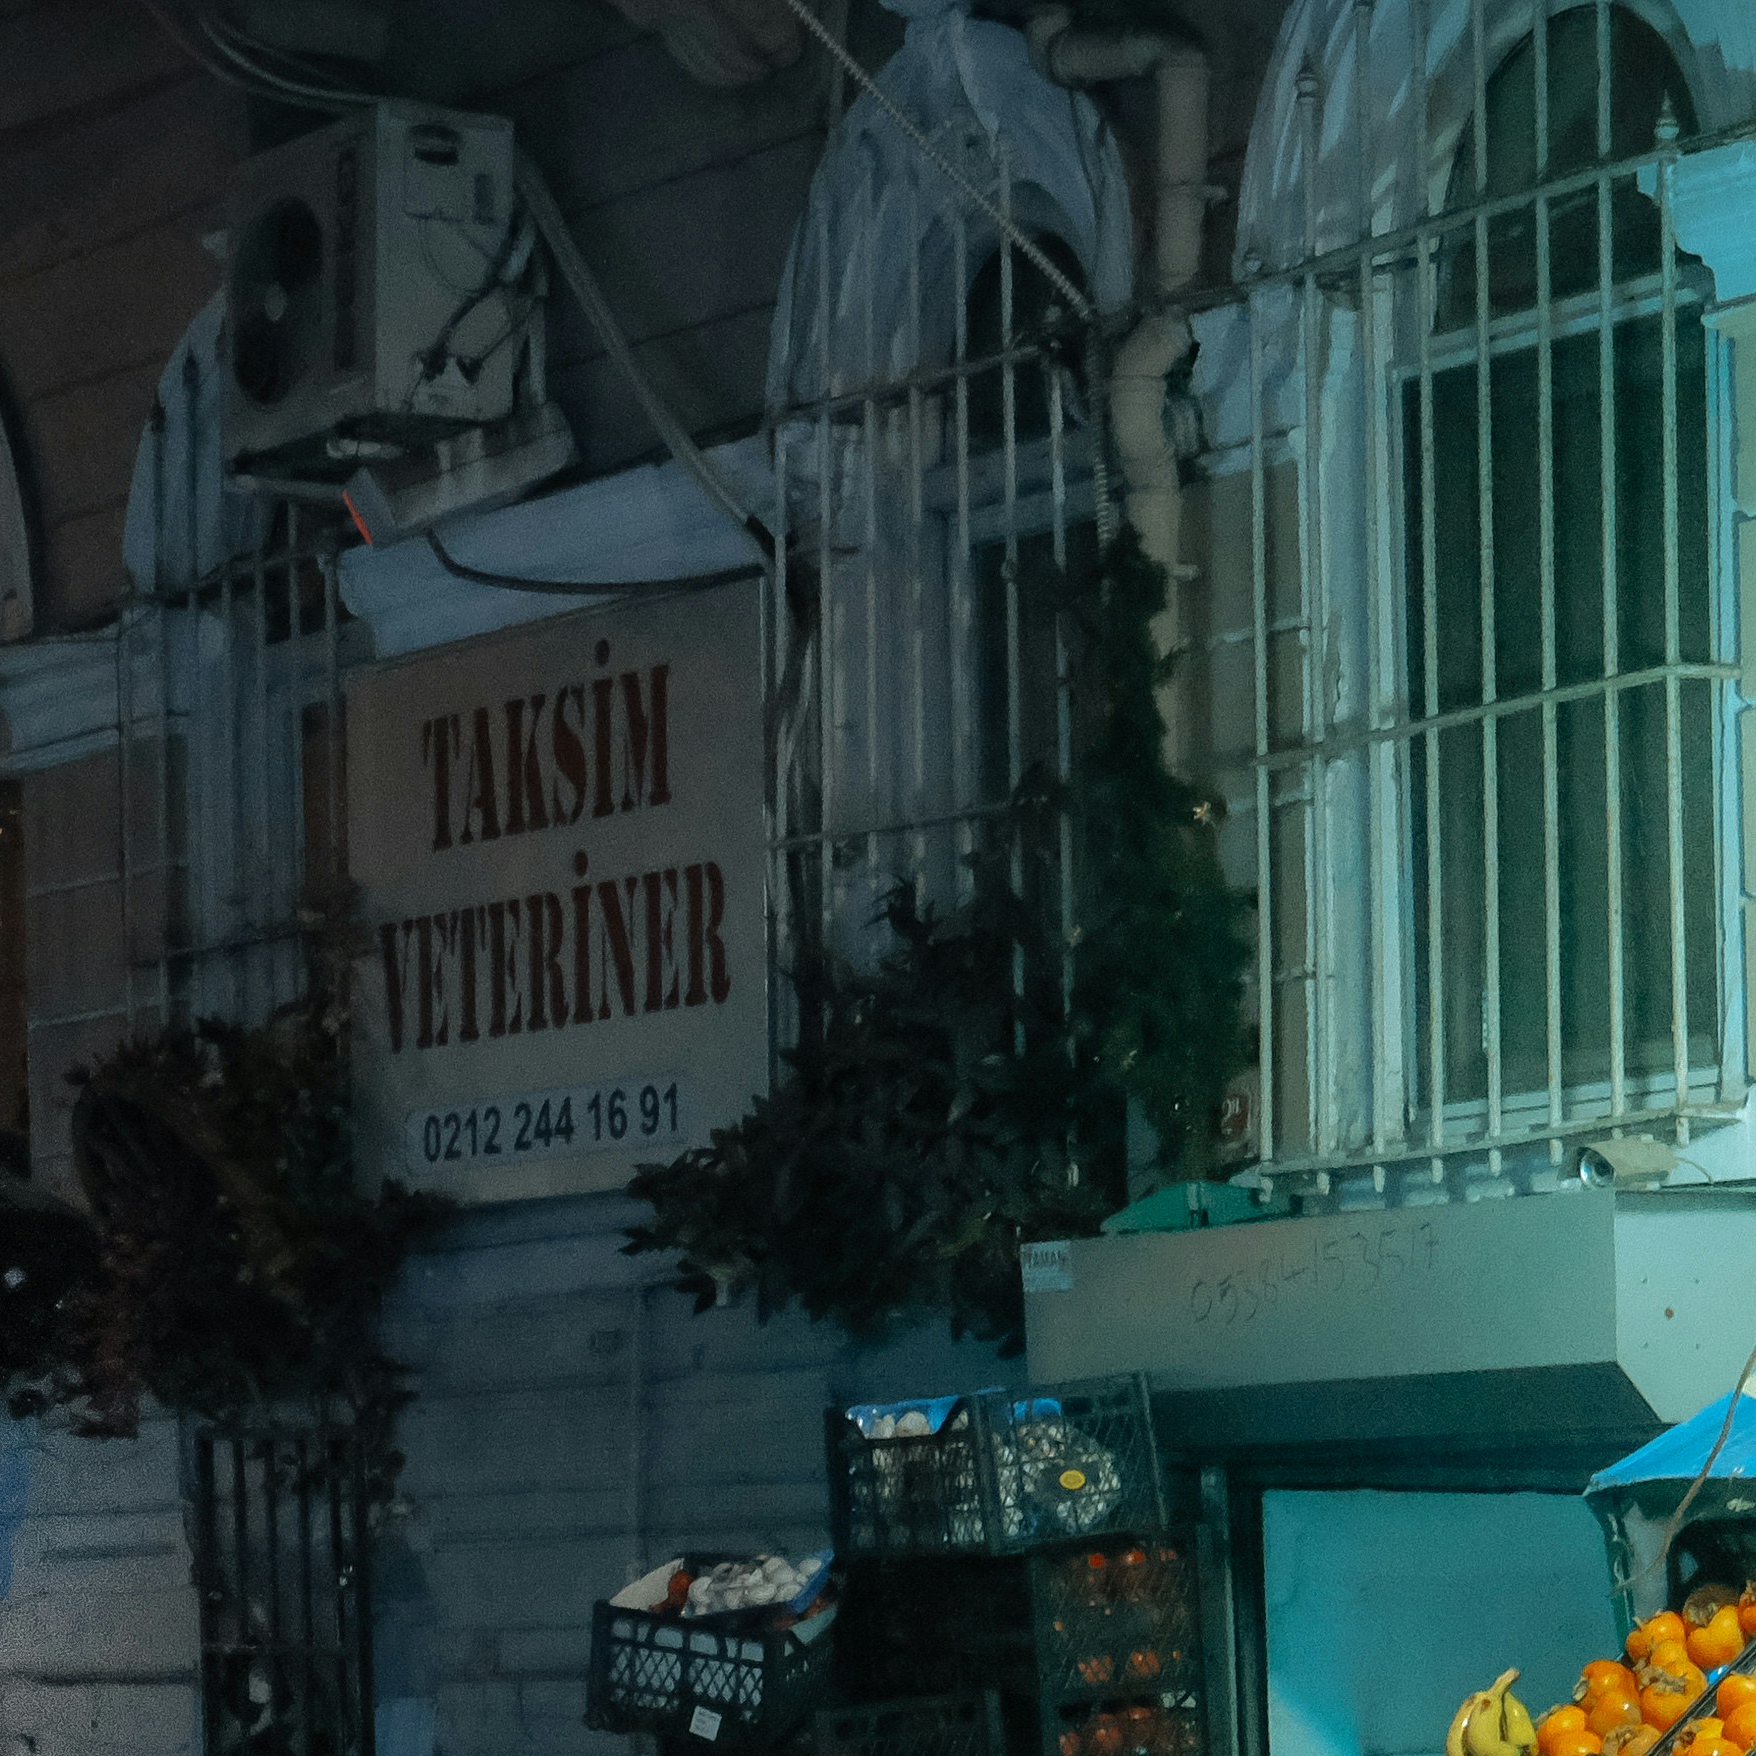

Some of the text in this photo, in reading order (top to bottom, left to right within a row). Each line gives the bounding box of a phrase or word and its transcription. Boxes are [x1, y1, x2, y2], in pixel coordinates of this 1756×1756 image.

[422, 639, 672, 852] TAKSİM
[380, 850, 731, 1055] VETERİNER
[422, 1082, 680, 1163] 0212 244 16 91
